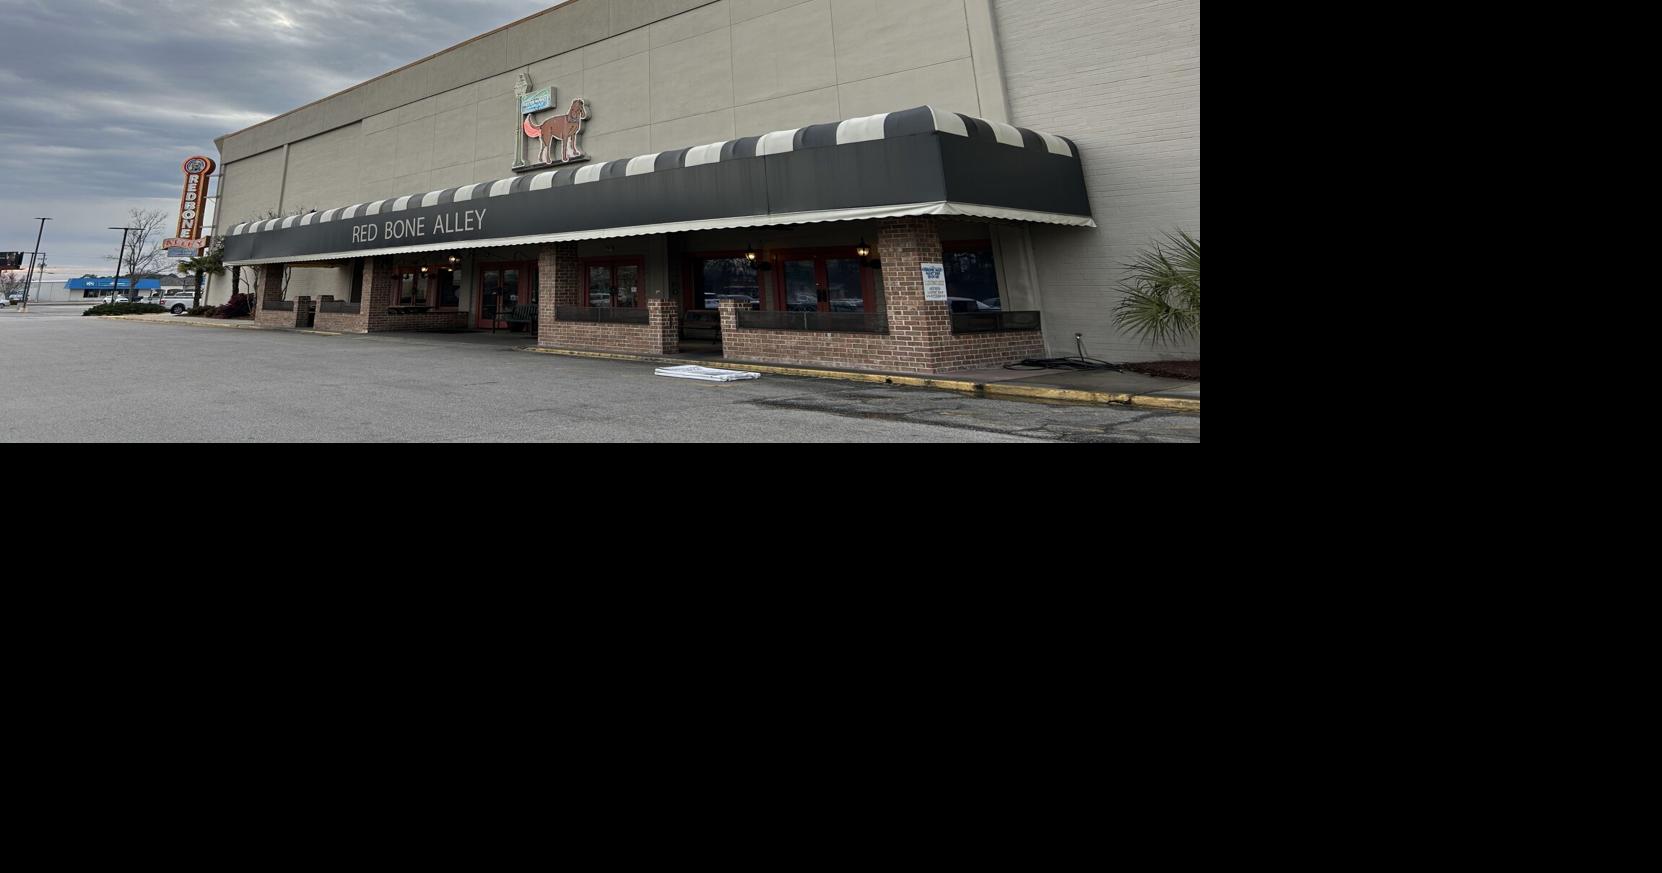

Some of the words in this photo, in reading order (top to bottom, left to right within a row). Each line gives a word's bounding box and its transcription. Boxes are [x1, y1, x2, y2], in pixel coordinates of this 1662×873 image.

[352, 223, 378, 244] RED
[384, 216, 425, 240] BONE
[432, 208, 487, 235] ALLEY
